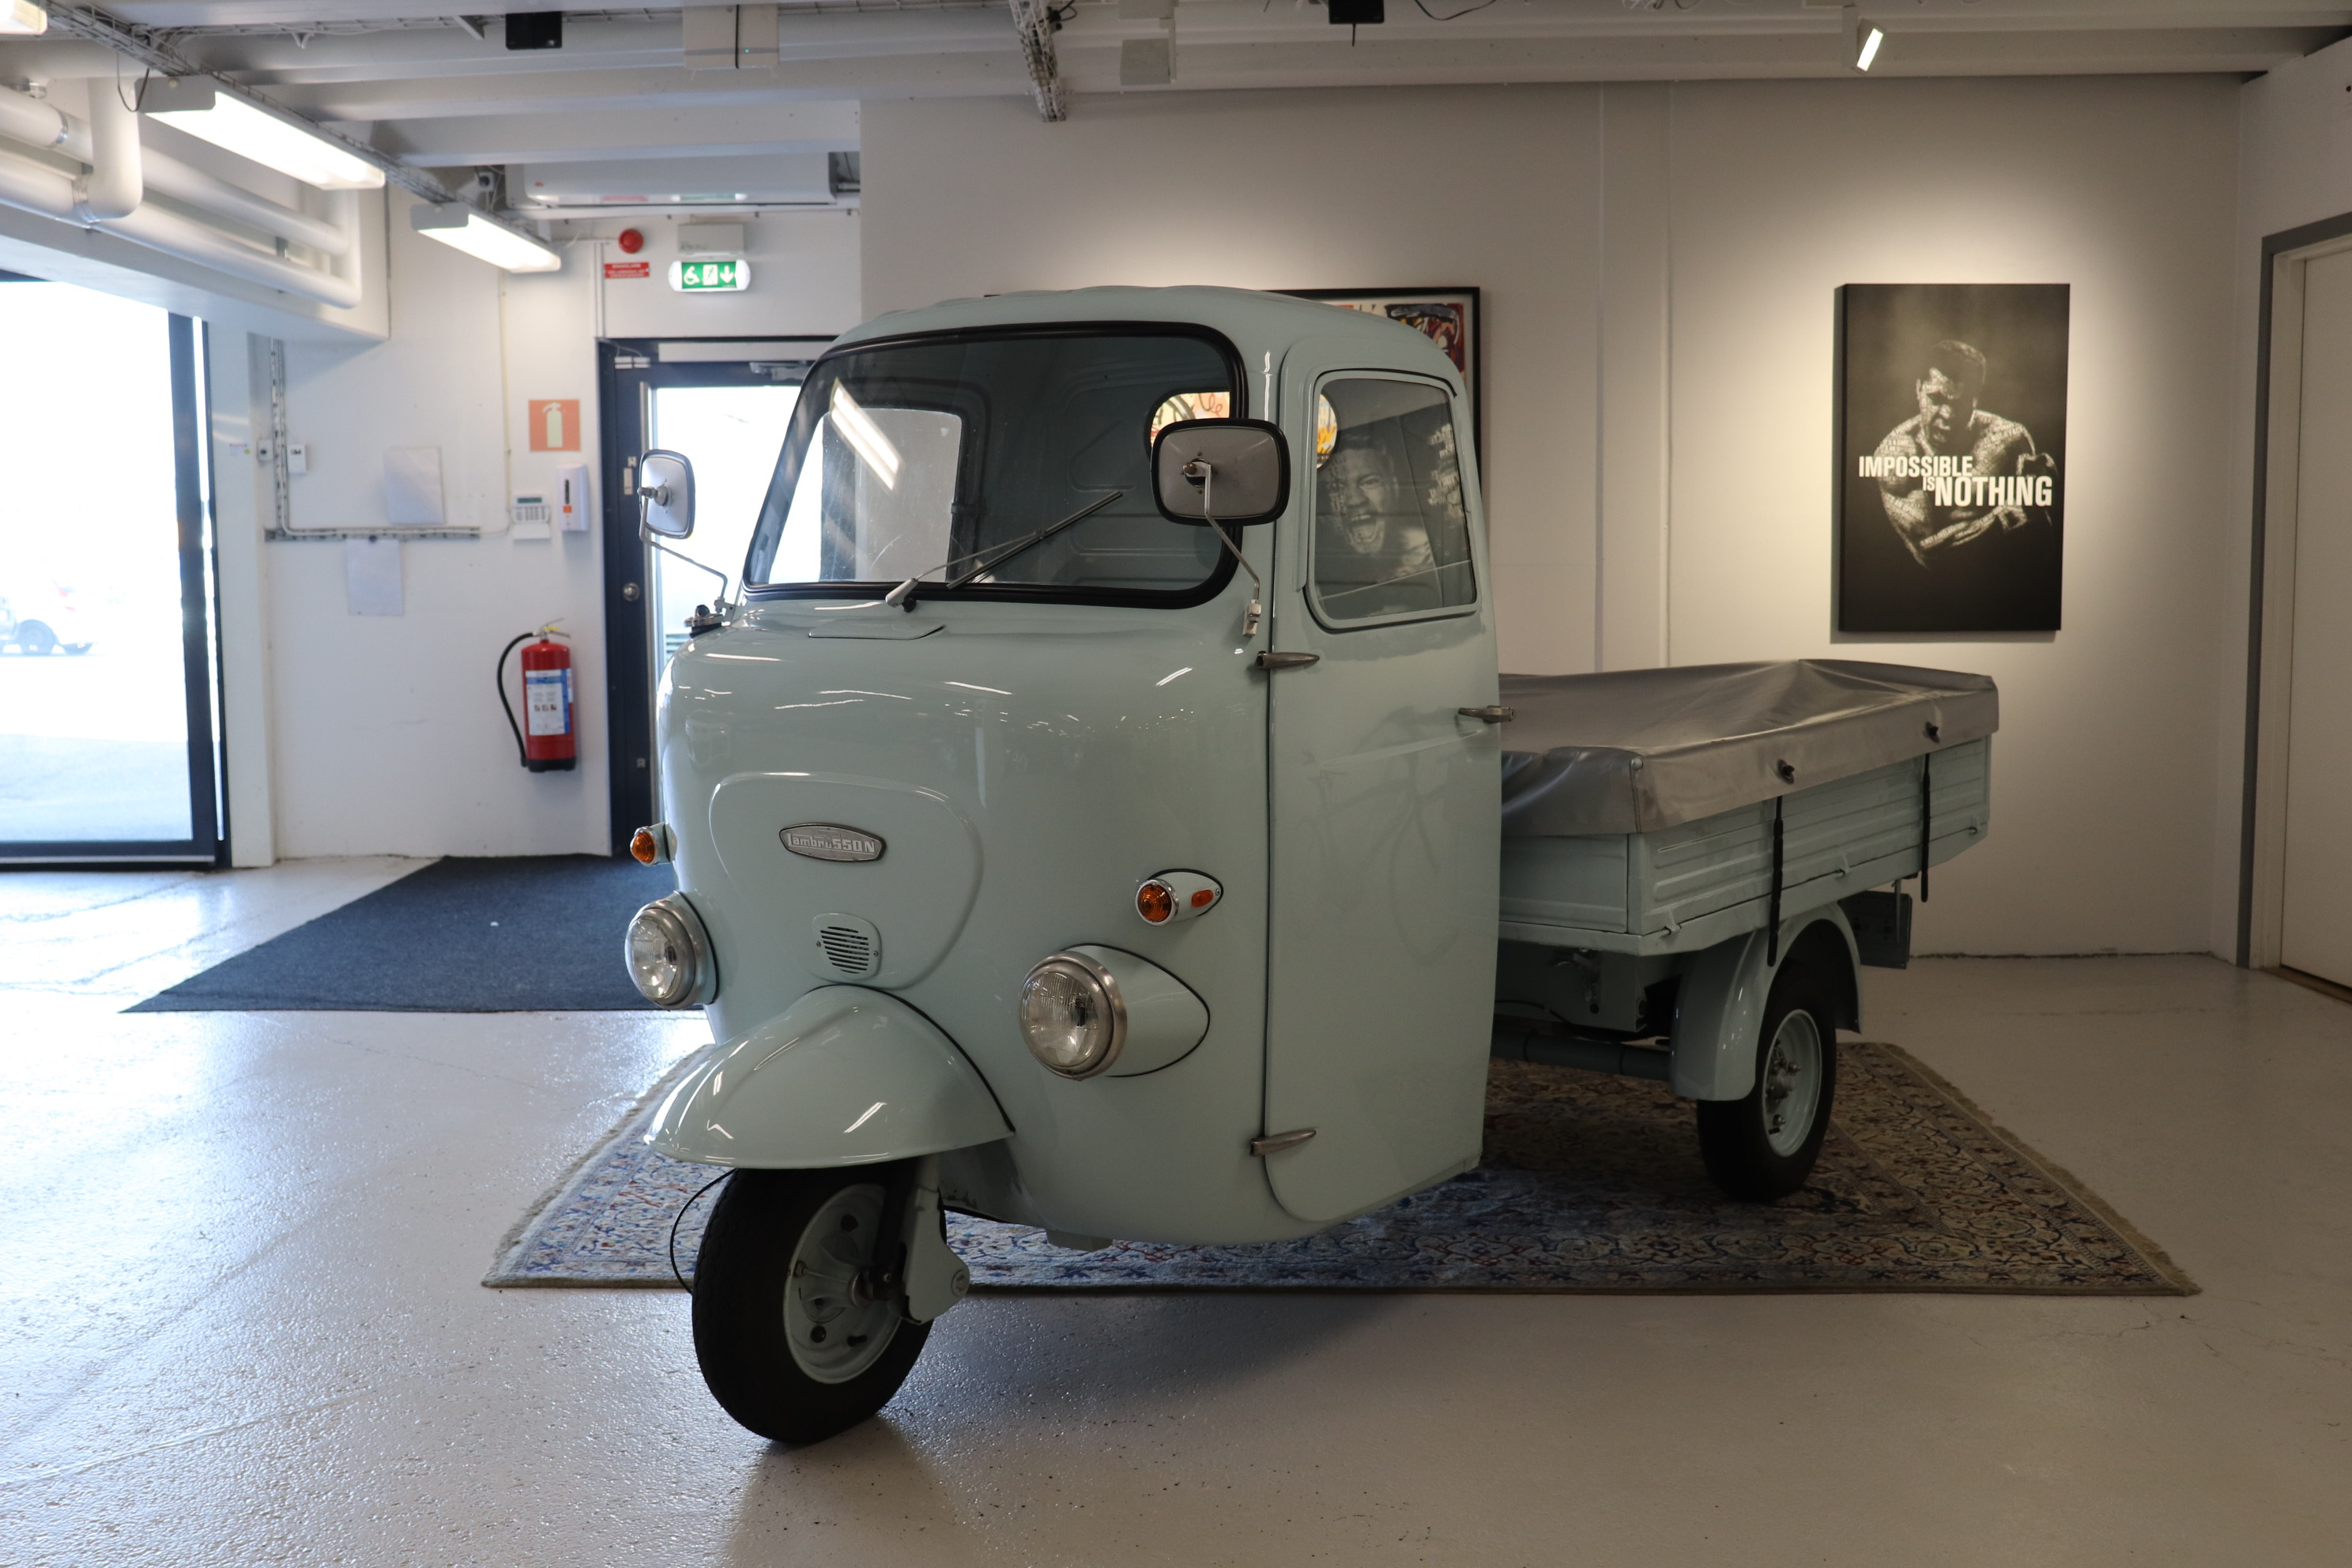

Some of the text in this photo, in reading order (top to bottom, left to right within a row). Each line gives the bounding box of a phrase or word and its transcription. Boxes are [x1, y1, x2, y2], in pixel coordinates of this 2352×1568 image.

[1859, 456, 1973, 477] IMPOSSIBLE
[1923, 476, 2052, 507] IS NOTHING
